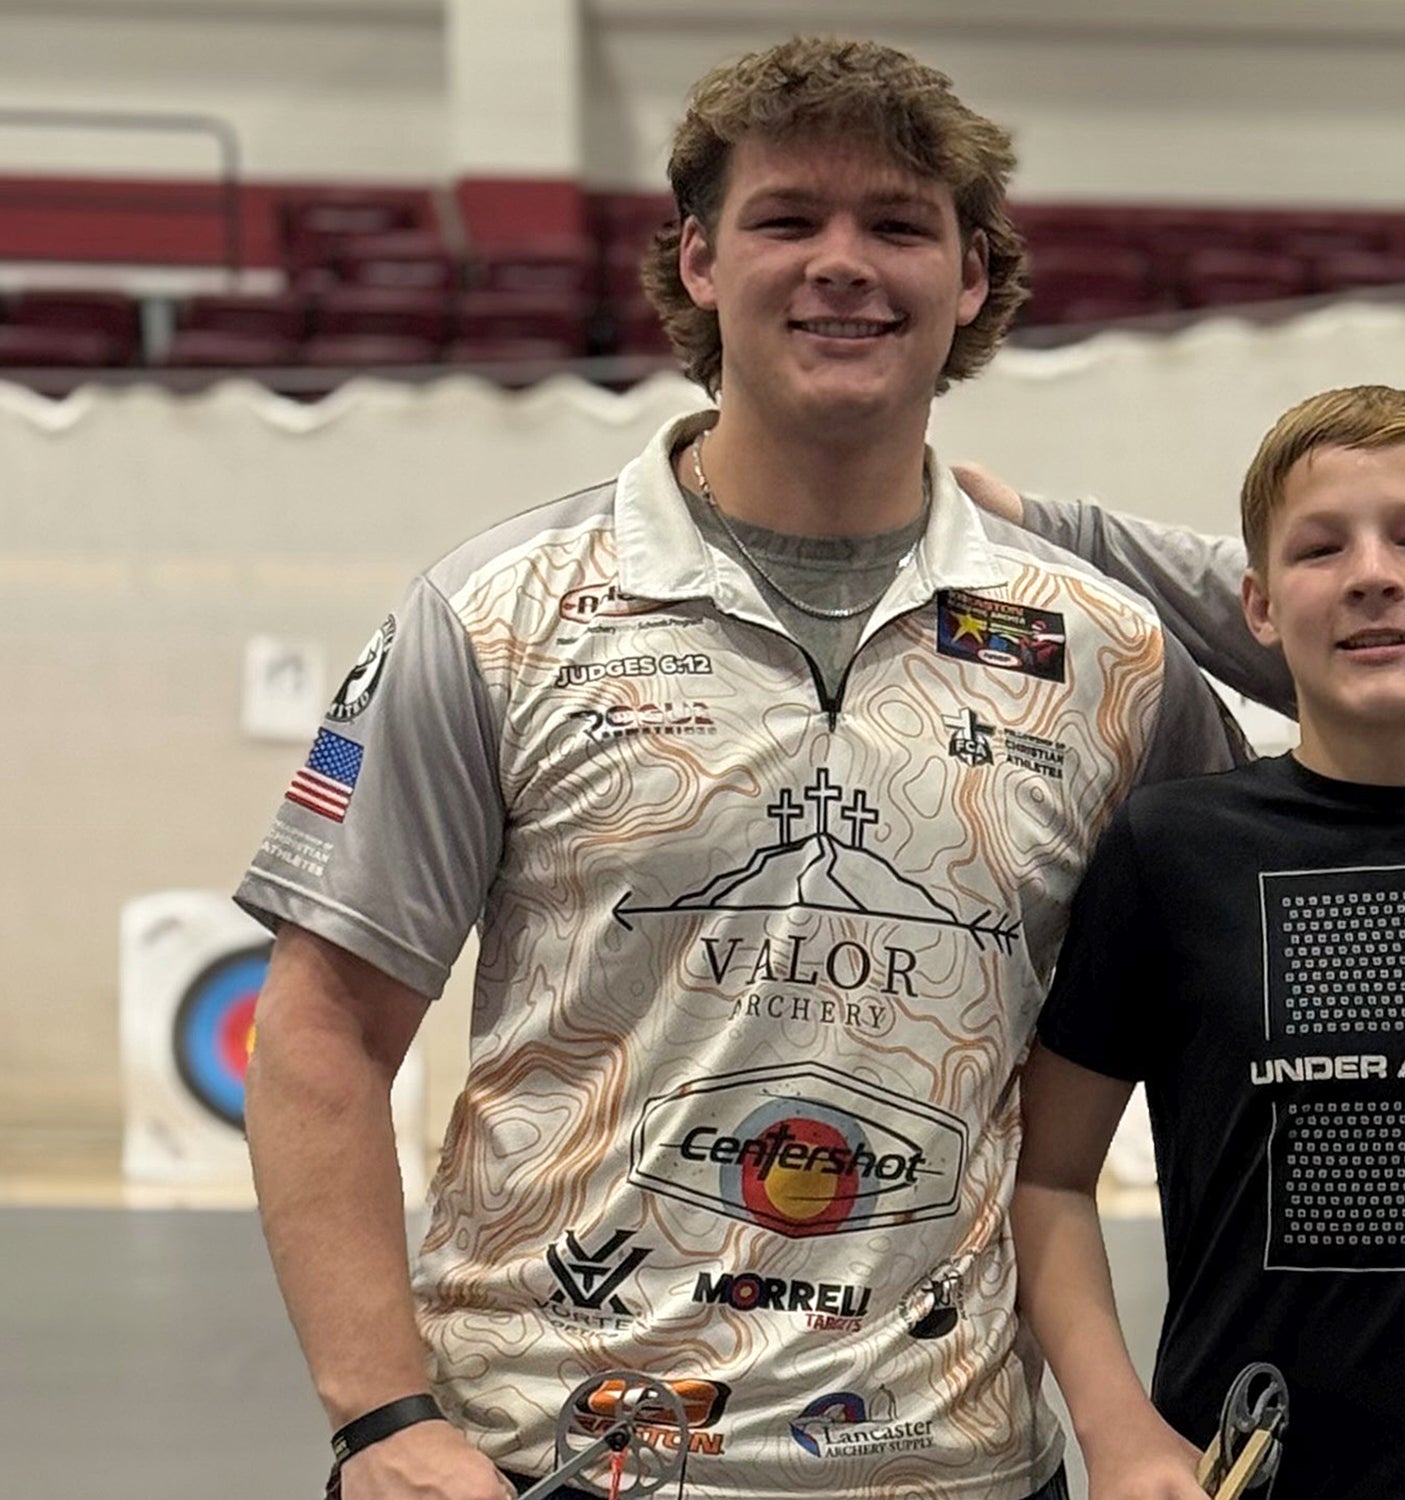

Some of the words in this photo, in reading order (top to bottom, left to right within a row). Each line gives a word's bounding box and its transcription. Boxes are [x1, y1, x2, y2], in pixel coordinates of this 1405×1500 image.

[555, 656, 657, 688] JUDGES
[659, 654, 713, 675] 6:12
[956, 739, 988, 758] FCA
[1005, 739, 1065, 766] CHRISTIAN
[1005, 754, 1064, 780] ATHLETES
[701, 935, 919, 998] VALOR
[728, 993, 887, 1030] ARCHERY
[1251, 1055, 1388, 1086] UNDER
[680, 1121, 928, 1184] Centershot
[692, 1271, 873, 1318] MORRELL
[823, 1419, 934, 1445] Lancaster
[825, 1444, 888, 1459] ARCHERY
[888, 1436, 935, 1453] SUPPLY
